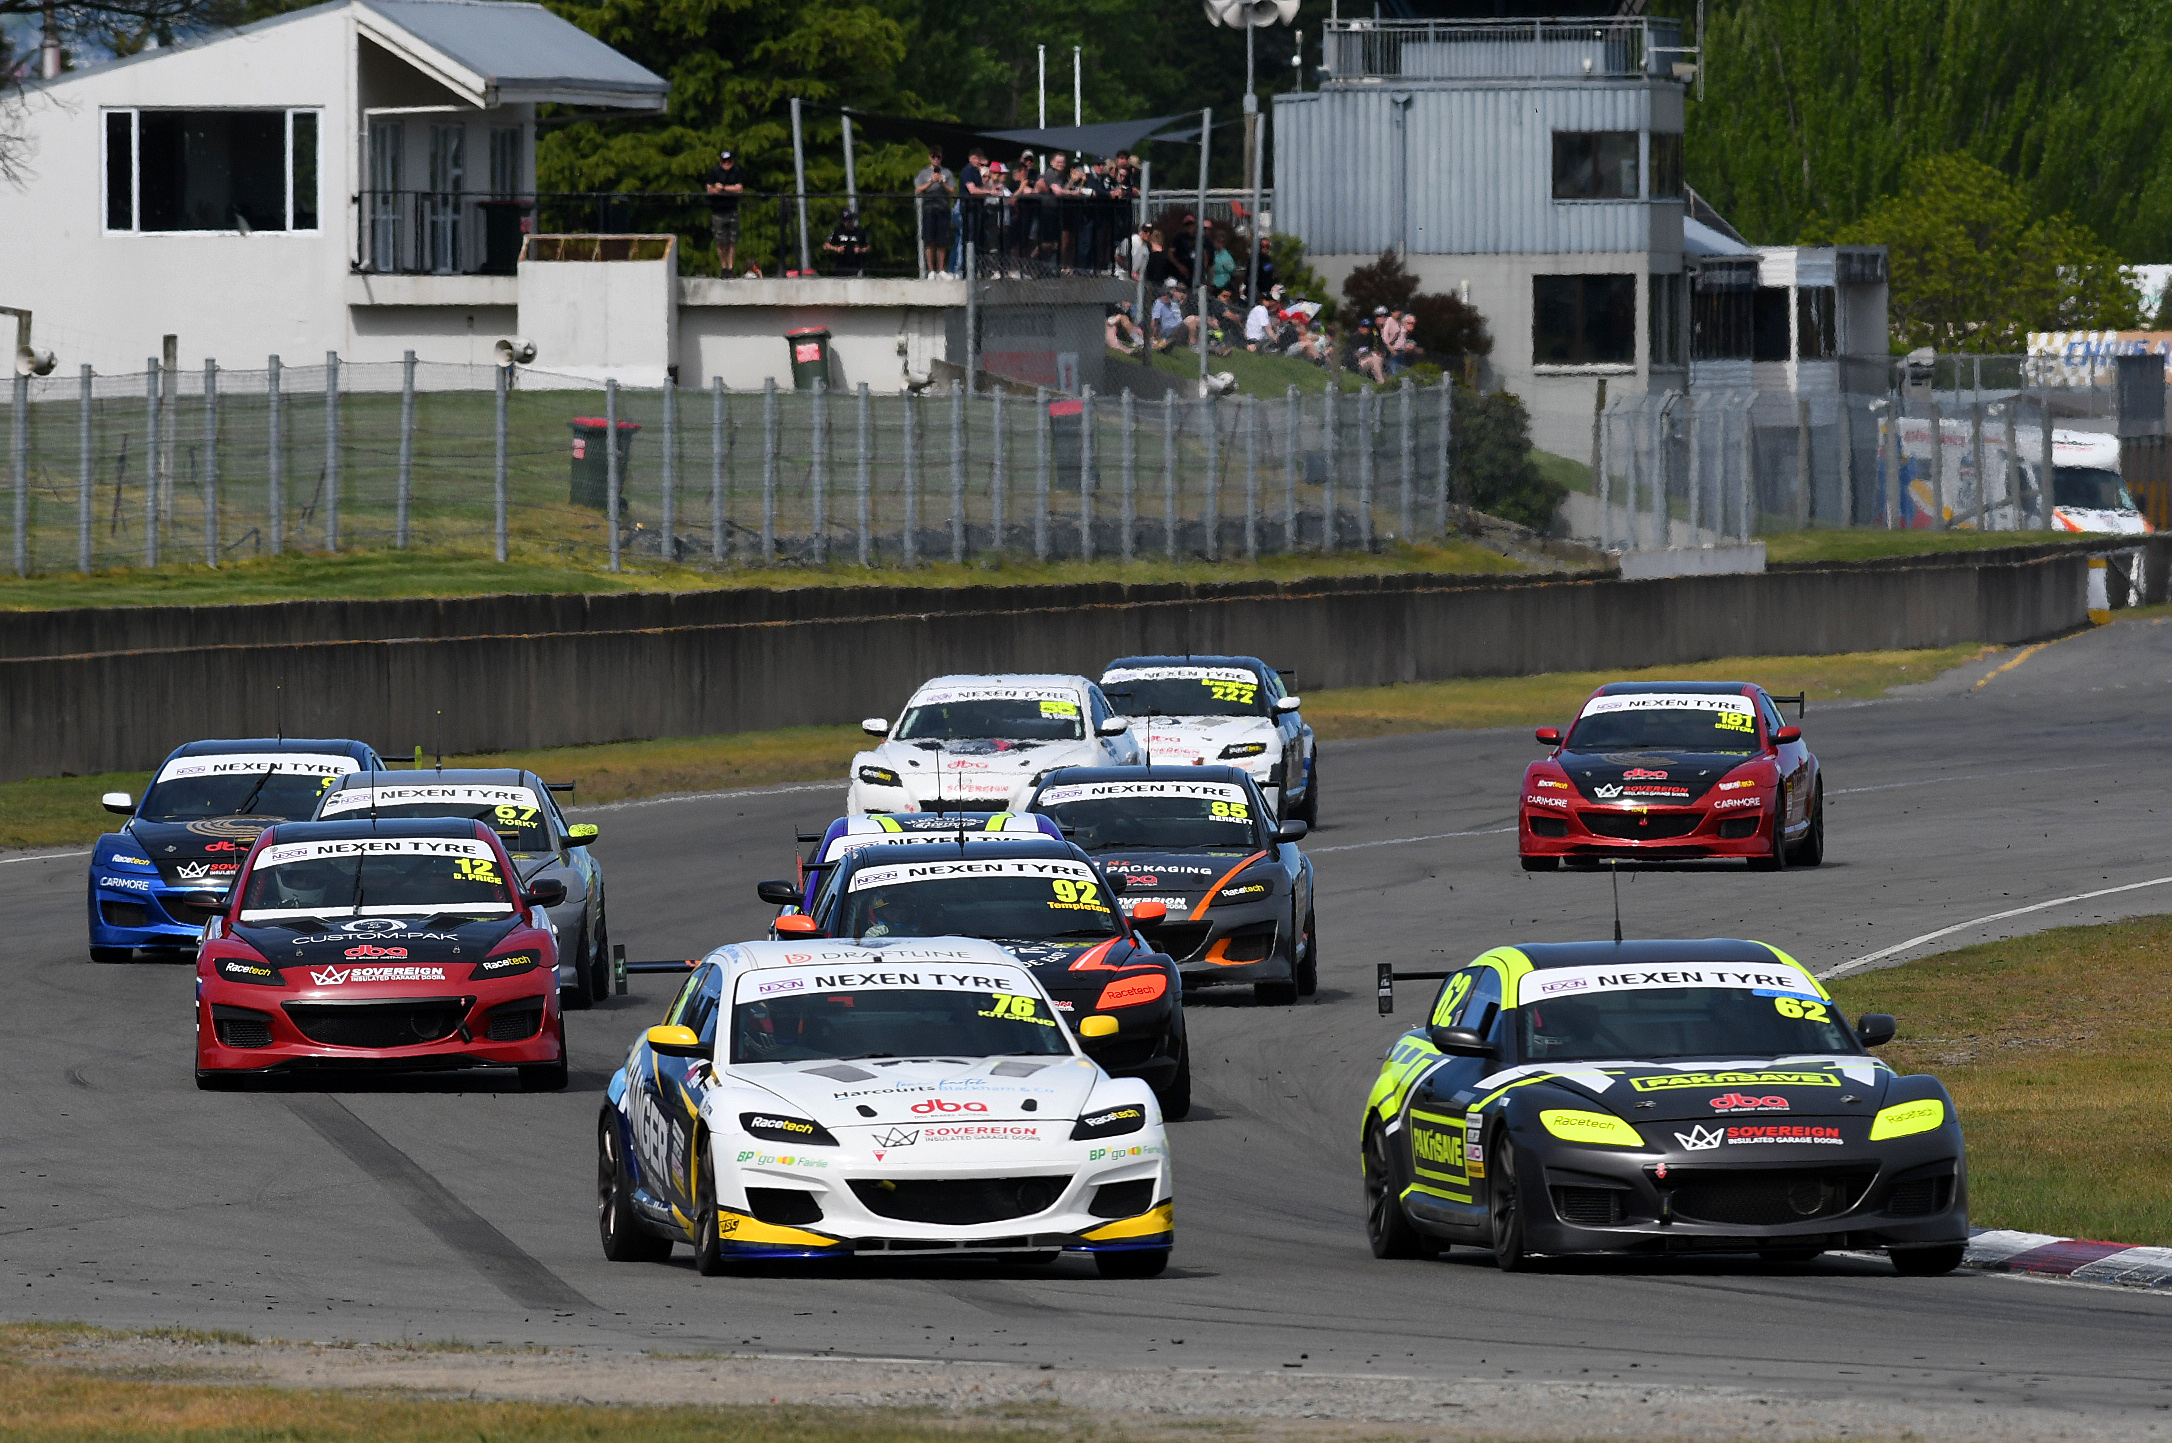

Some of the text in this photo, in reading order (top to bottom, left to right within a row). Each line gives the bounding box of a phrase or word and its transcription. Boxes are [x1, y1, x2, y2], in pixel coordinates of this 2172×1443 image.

[1211, 687, 1254, 705] 222
[1629, 699, 1742, 711] NEXEN TYRE
[1718, 711, 1753, 728] 181
[213, 762, 346, 776] NEXEN TYRE
[1623, 768, 1669, 779] dba
[380, 789, 524, 802] NEXEN TYRE
[1091, 784, 1232, 797] NEXEN TYRE
[494, 805, 539, 821] 67
[1211, 801, 1248, 818] 85
[498, 818, 539, 829] TORKY
[318, 841, 477, 856] NEXEN TYRE
[112, 854, 151, 867] Racetech
[454, 857, 495, 878] 12
[908, 862, 1088, 877] NEXEN TYRE
[1106, 865, 1213, 875] PACKAGING
[99, 877, 150, 891] CARNMORE
[1221, 884, 1265, 898] Racetech
[1052, 879, 1101, 905] 92
[1047, 901, 1111, 914] Templeton
[292, 932, 459, 945] CUSTOM-PAK
[344, 944, 409, 957] dba
[225, 962, 272, 977] Racetech
[483, 955, 532, 970] Racetech
[351, 967, 444, 976] SOVEREIGN
[815, 973, 1014, 991] NEXEN TYRE
[1597, 971, 1795, 988] NEXEN TYRE
[1106, 985, 1156, 1000] Racetech
[1432, 972, 1472, 1027] 62
[991, 993, 1036, 1018] 76
[1774, 997, 1831, 1024] 62
[977, 1009, 1056, 1027] KITCHING
[834, 1086, 936, 1099] Harcourts
[910, 1099, 988, 1114] dba
[1709, 1092, 1789, 1109] dba
[1084, 1108, 1141, 1128] Racetech
[1886, 1106, 1938, 1124] Racetech
[751, 1117, 814, 1134] Racetech
[1553, 1115, 1616, 1131] Racetech
[924, 1127, 1039, 1136] SOVEREIGN
[1011, 1134, 1043, 1142] DOORS
[1727, 1126, 1840, 1138] SOVEREIGN
[1728, 1136, 1845, 1145] INSULATED GARAGE DOORS
[737, 1151, 828, 1168] BP go Fairlie
[1089, 1148, 1106, 1161] BP
[1111, 1149, 1126, 1161] go
